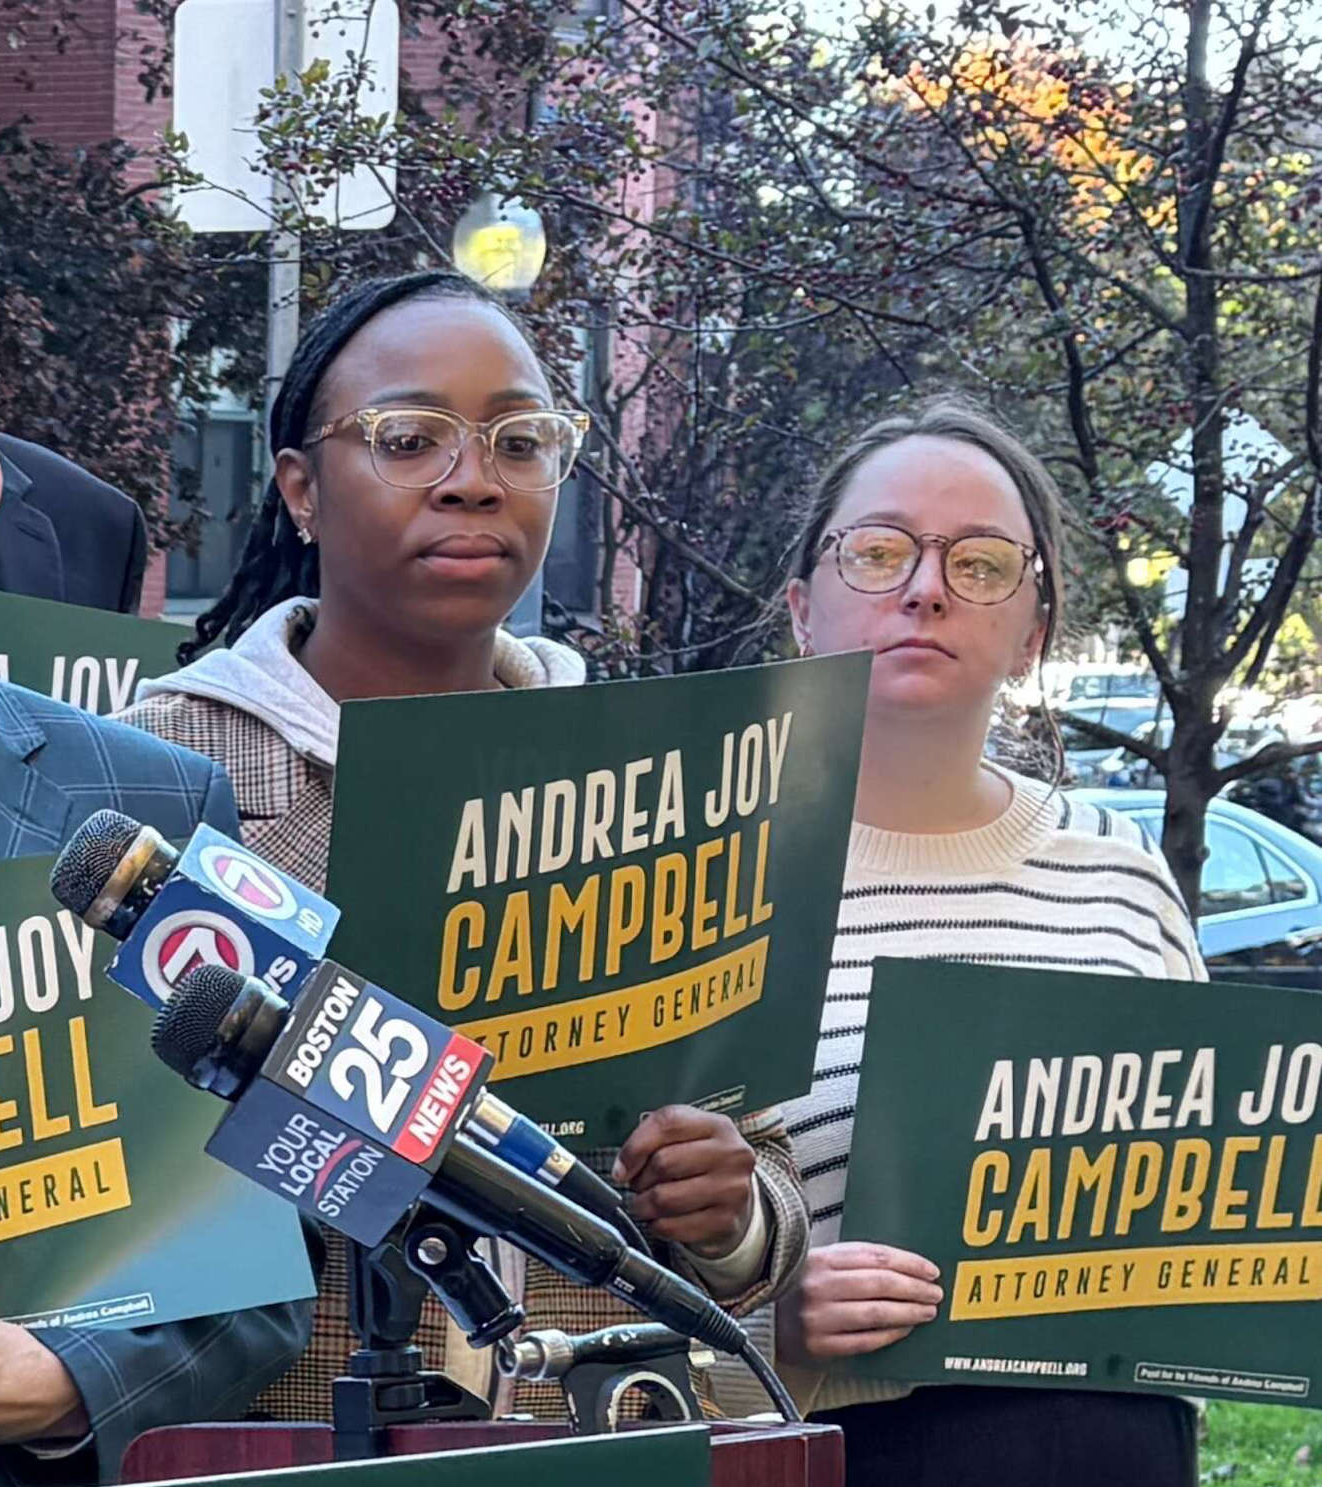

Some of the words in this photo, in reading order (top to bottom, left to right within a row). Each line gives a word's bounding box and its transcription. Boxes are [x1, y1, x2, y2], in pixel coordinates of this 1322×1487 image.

[447, 750, 685, 893] ANDREA
[704, 712, 792, 828] JOY
[296, 907, 325, 938] HD
[438, 820, 774, 1012] CAMPBELL
[287, 977, 359, 1086] BOSTON
[480, 1004, 629, 1062] TORNEY
[654, 959, 754, 1027] GENERAL
[330, 998, 428, 1132] 25
[408, 1054, 471, 1146] NEWS
[975, 1048, 1214, 1141] ANDREA
[1239, 1043, 1322, 1125] JO
[257, 1114, 319, 1174] YOUR
[280, 1131, 346, 1195] LOCAL
[318, 1145, 383, 1216] STATION
[968, 1262, 1135, 1304] ATTORNEY
[1158, 1256, 1309, 1289] GENERAL
